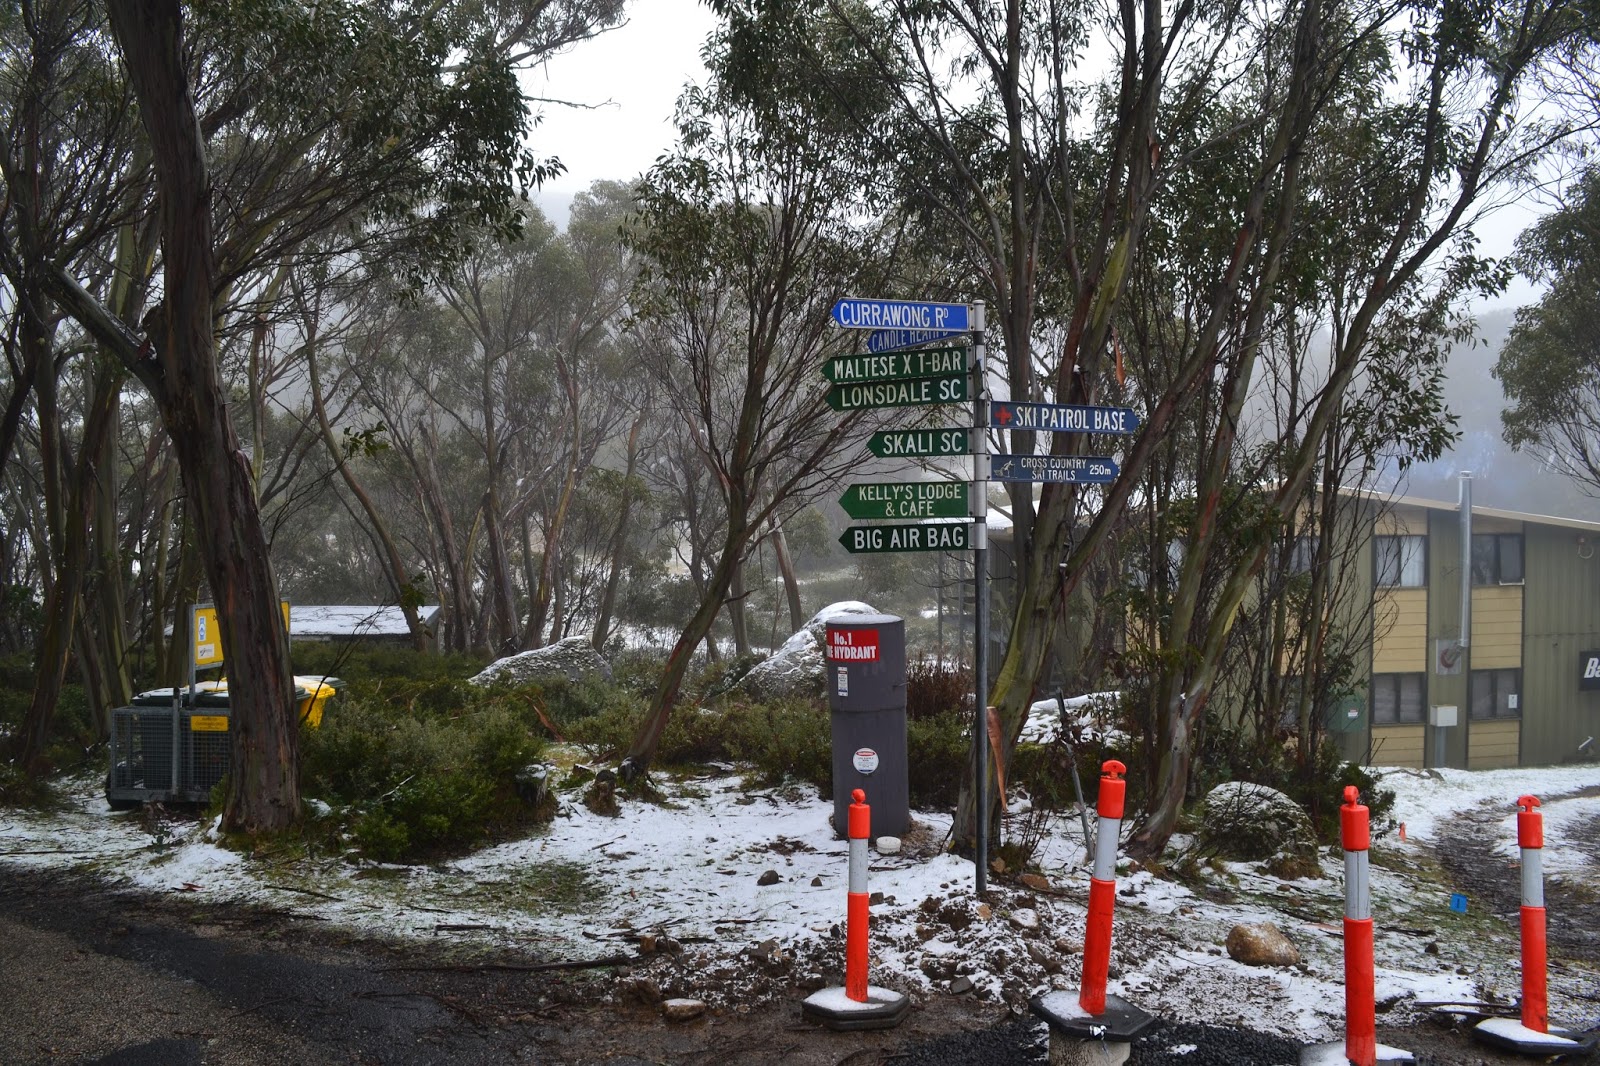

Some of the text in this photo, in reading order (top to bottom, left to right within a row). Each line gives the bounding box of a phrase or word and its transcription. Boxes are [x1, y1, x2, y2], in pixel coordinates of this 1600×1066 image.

[839, 302, 930, 328] CURRAWONG
[872, 330, 907, 352] CANDLE
[834, 350, 962, 379] MALTESE X T-BAR
[841, 379, 962, 407] LONSDALE SC
[1016, 406, 1126, 431] SKI PATROL BASE
[882, 431, 963, 455] SKALI SC
[1021, 457, 1087, 469] CROSS COUNTRY
[1089, 465, 1111, 476] 250m
[1032, 469, 1076, 480] SKI TRAILS
[859, 483, 962, 501] KELLY'S LODGE
[885, 502, 896, 517] &
[854, 525, 964, 550] BIG AIR BAG
[834, 645, 876, 659] HYDRANT
